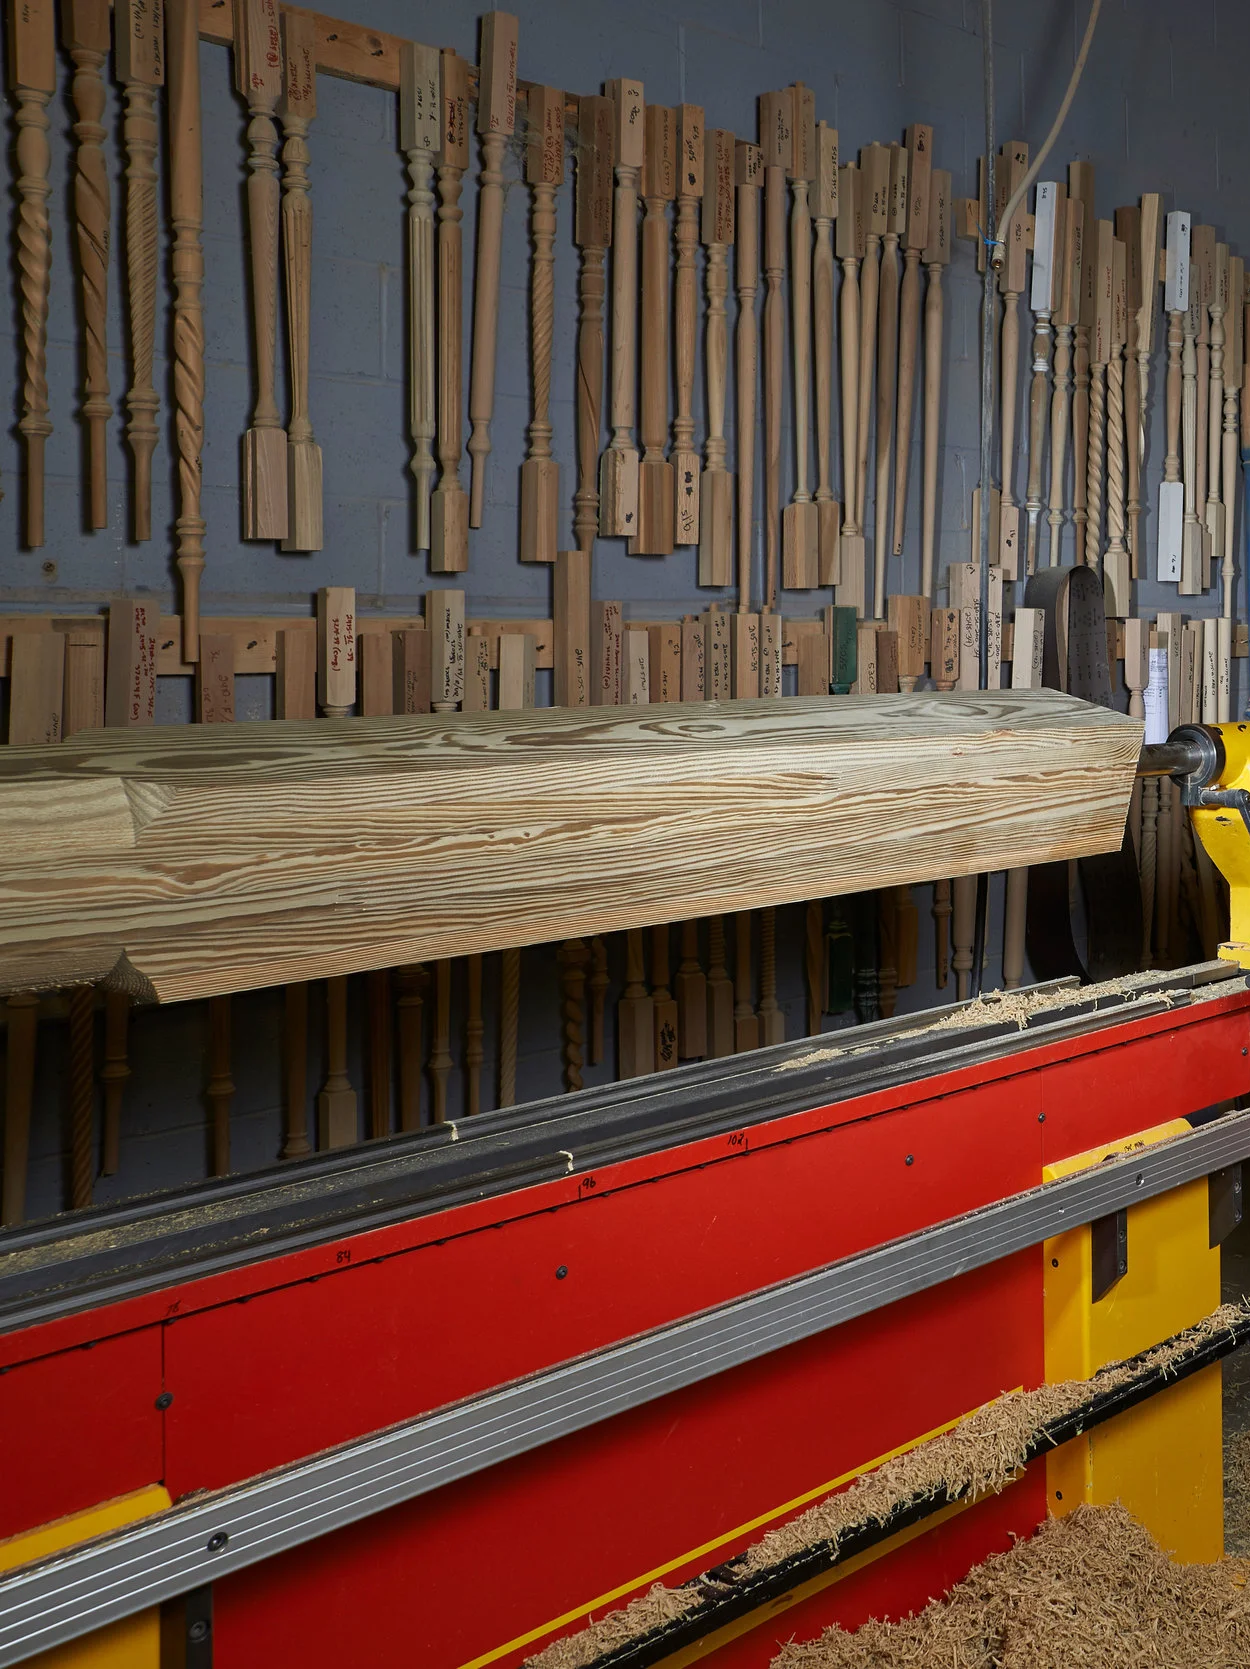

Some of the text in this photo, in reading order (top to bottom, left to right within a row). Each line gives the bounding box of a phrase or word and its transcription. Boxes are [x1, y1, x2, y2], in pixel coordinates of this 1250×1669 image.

[727, 1131, 745, 1146] 102
[582, 1176, 597, 1190] 96
[336, 1248, 351, 1264] 84
